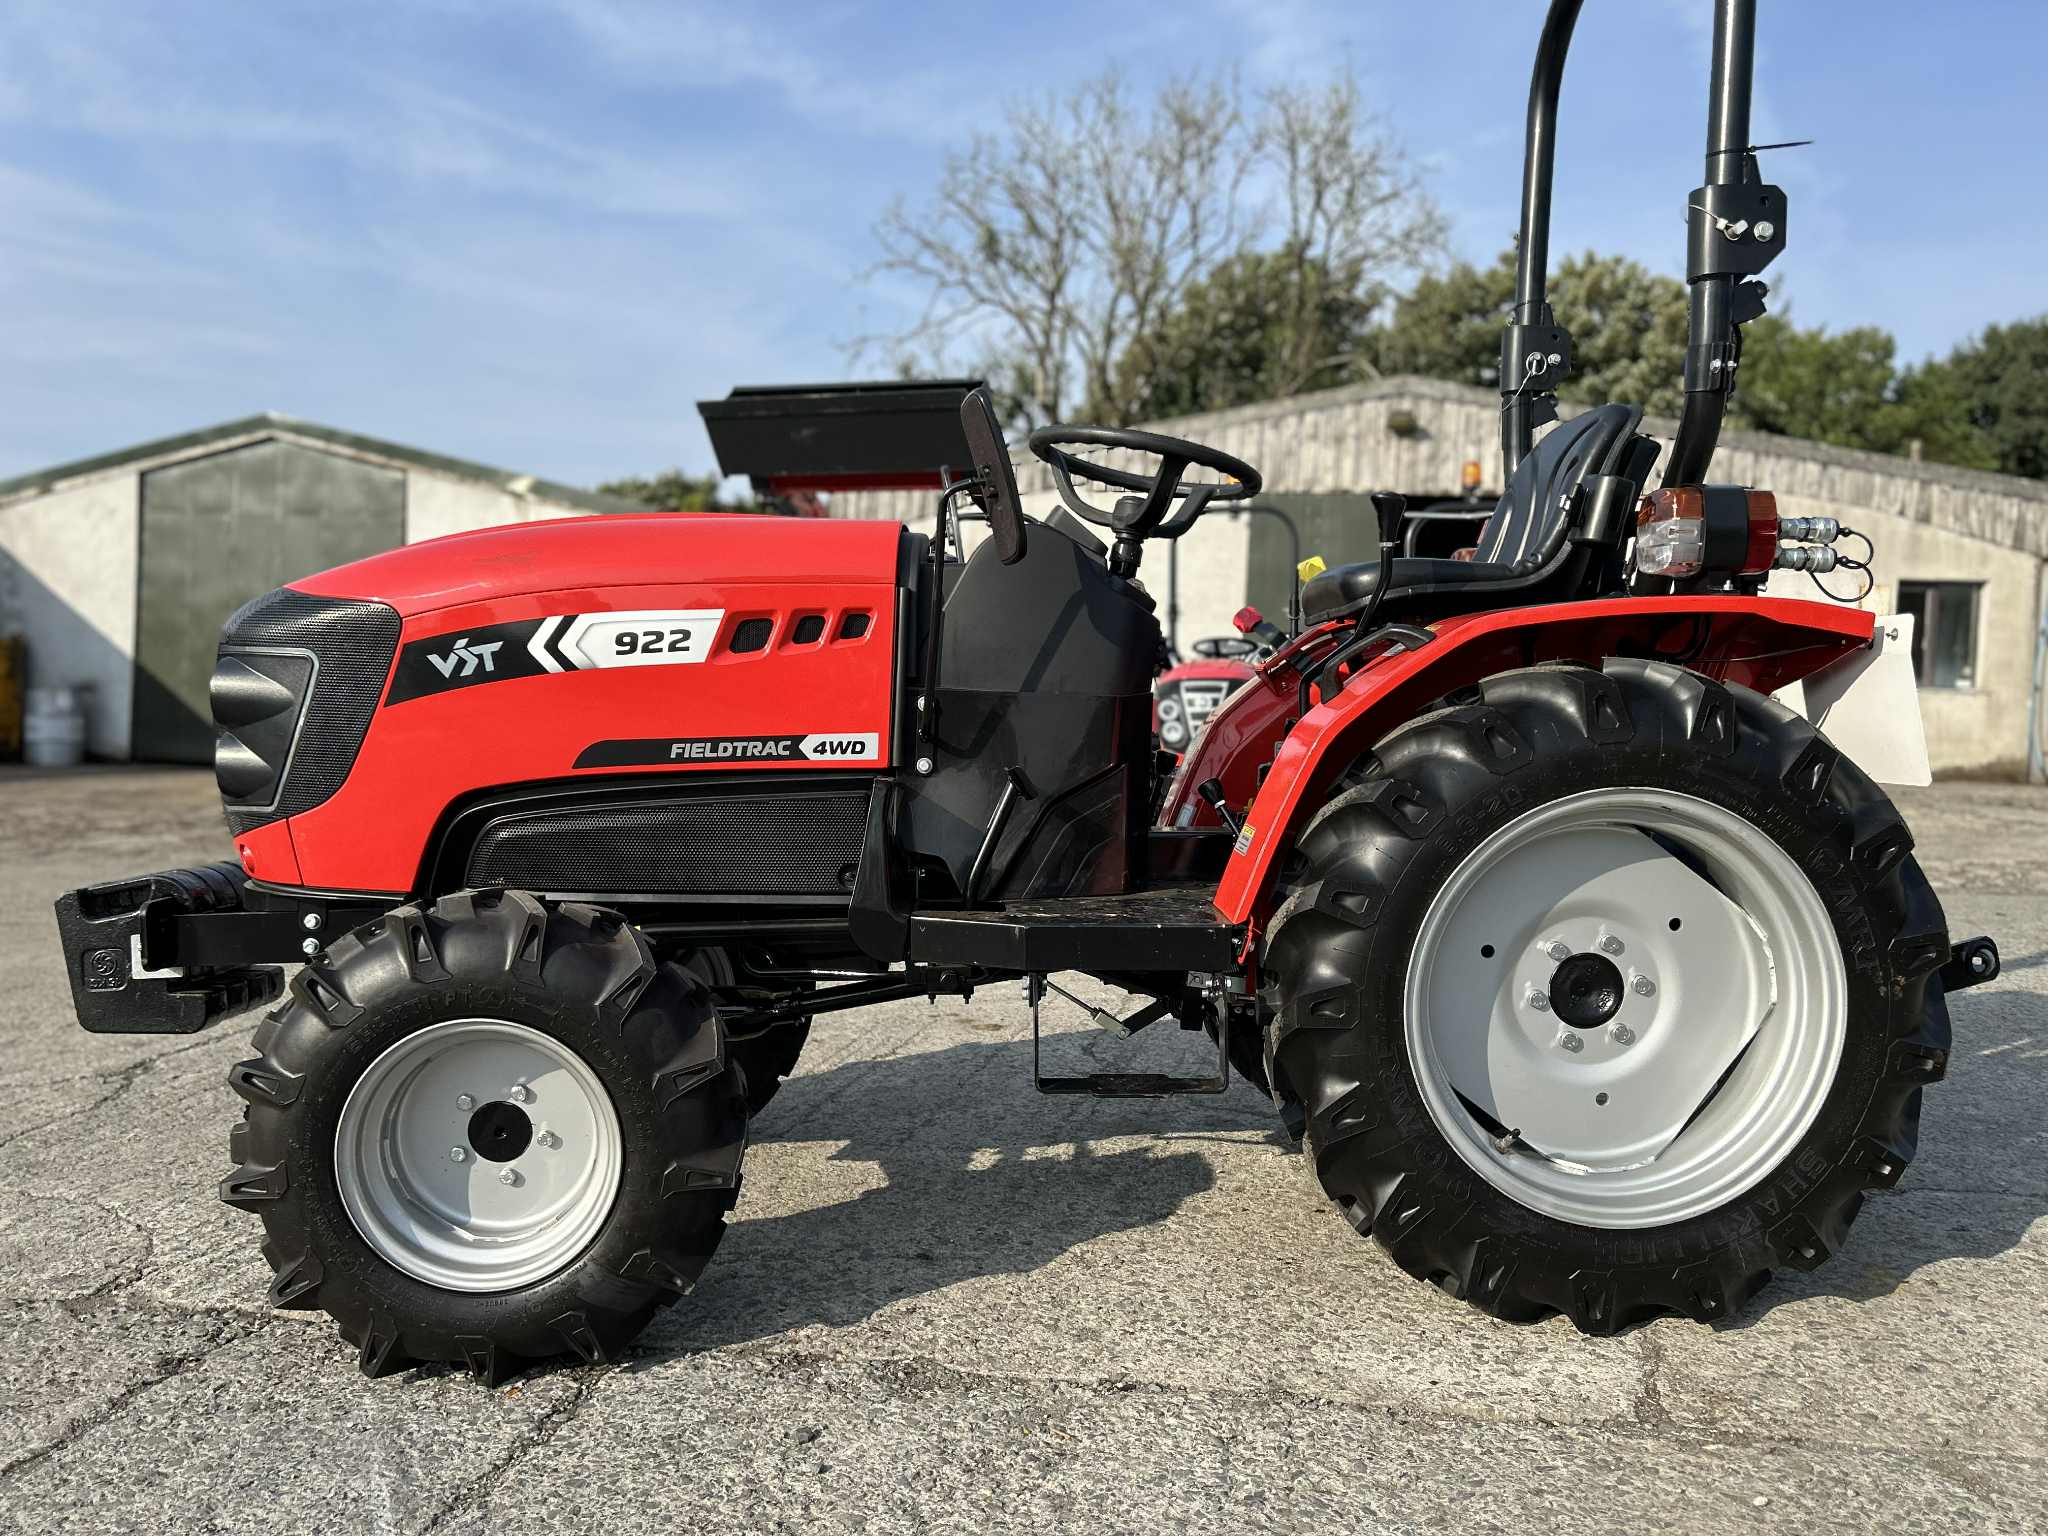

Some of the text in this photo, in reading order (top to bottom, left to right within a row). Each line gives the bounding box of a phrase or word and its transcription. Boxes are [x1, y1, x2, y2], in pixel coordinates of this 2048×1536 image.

[614, 628, 692, 656] 922
[670, 740, 792, 759] FIELDTRAC
[812, 740, 866, 755] 4WD
